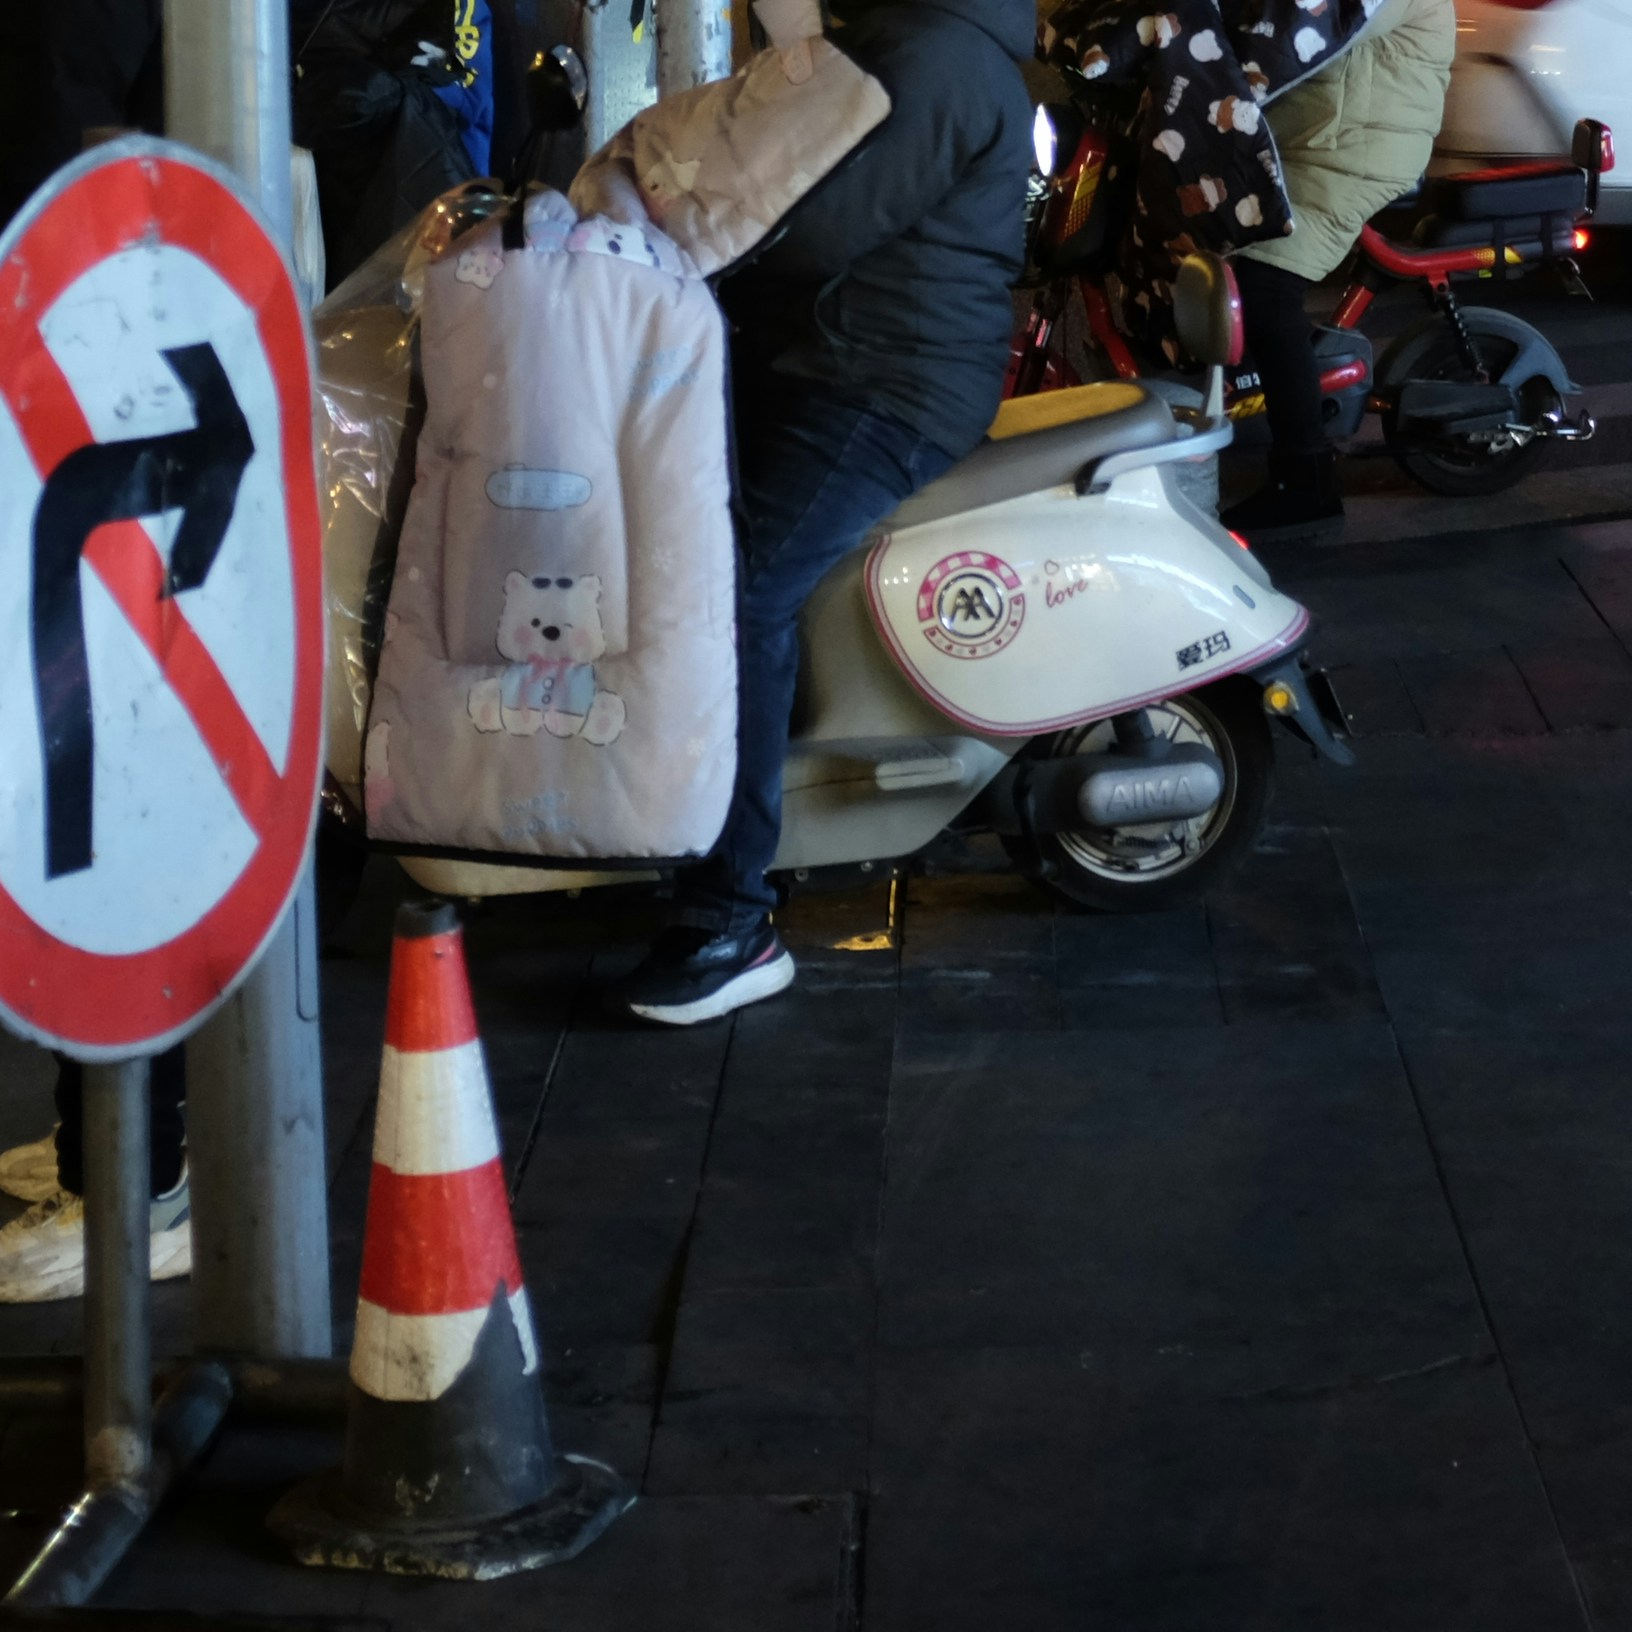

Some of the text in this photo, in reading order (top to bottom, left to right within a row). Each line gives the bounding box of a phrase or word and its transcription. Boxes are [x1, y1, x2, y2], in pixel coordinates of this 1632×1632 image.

[1045, 579, 1088, 608] love
[1175, 630, 1232, 672] 爱玛
[1106, 775, 1194, 814] AIMA
